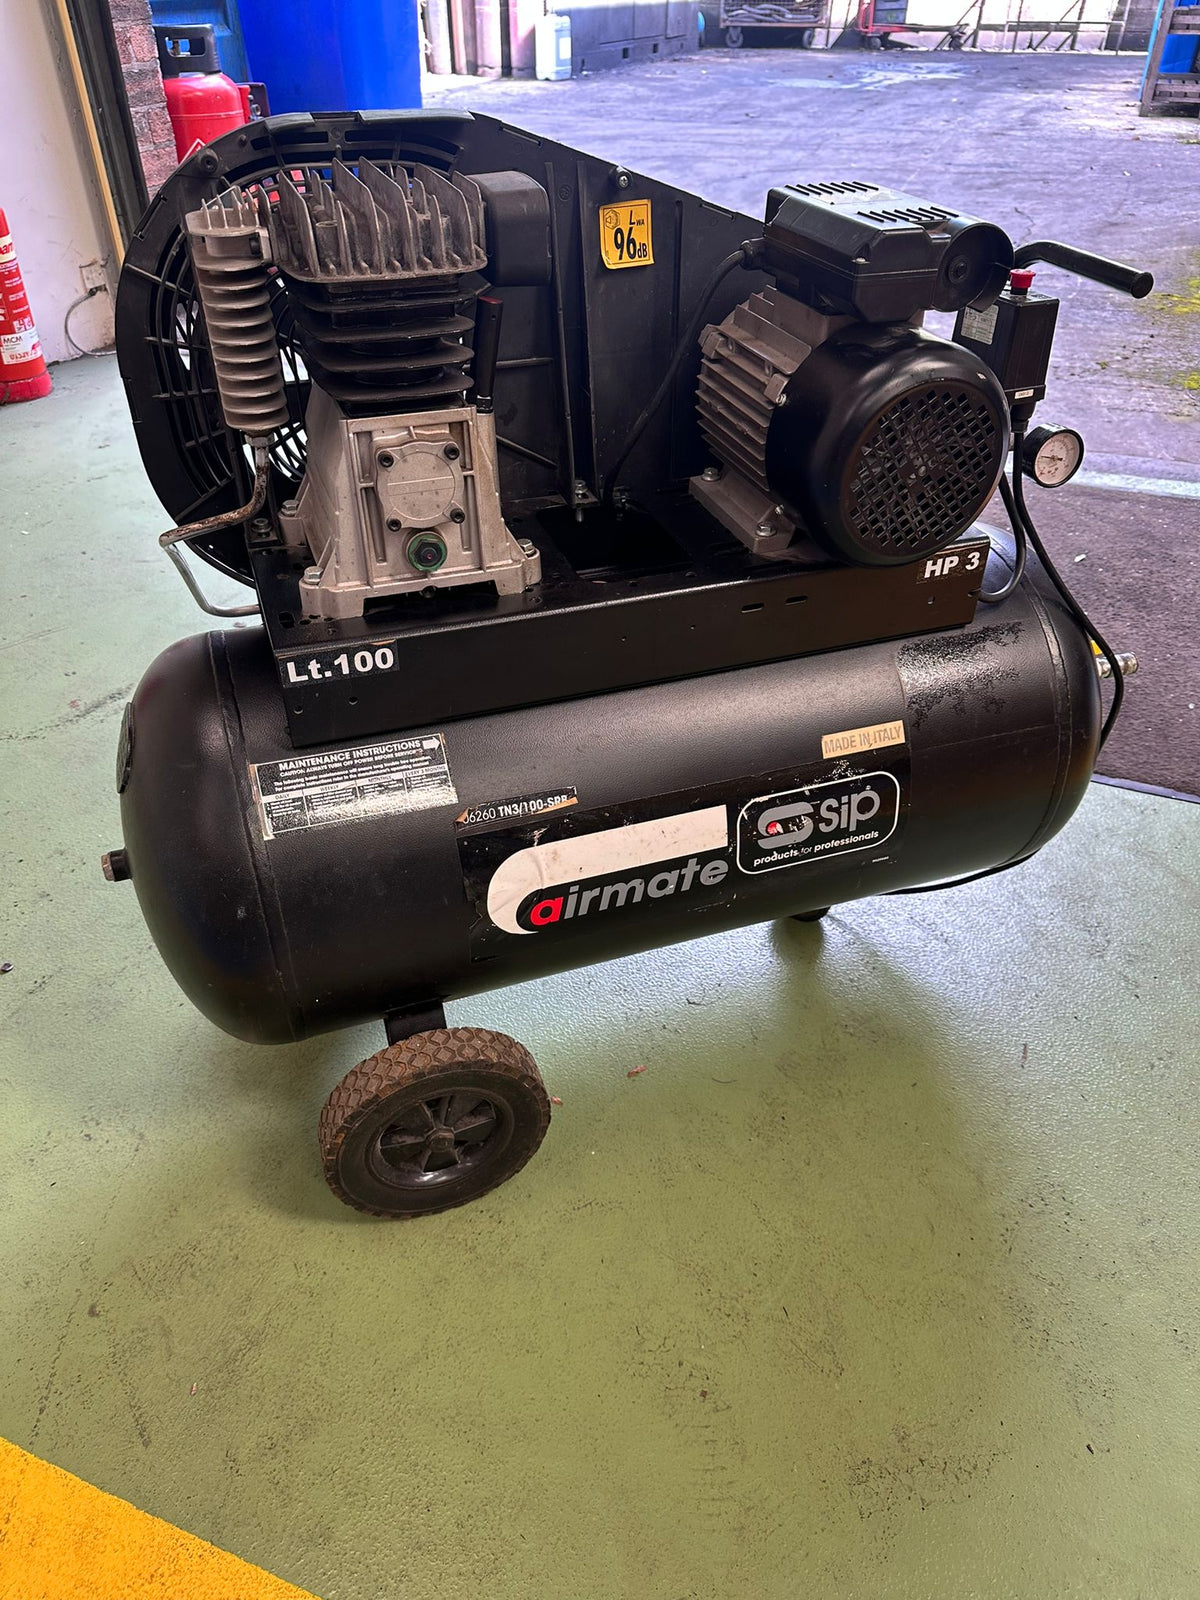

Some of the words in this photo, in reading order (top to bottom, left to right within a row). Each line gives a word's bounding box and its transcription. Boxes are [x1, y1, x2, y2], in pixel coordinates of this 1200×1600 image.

[3, 336, 23, 344] MCM
[924, 555, 960, 578] HP
[965, 551, 980, 570] 3
[286, 648, 394, 683] Lt.100
[824, 735, 857, 754] MADE
[858, 731, 871, 746] IN
[873, 726, 901, 744] ITALY
[279, 752, 351, 771] MAINTENANCE
[353, 740, 421, 758] INSTRUCTIONS
[306, 764, 328, 772] ALWAYS
[368, 775, 392, 783] MONTHLY
[753, 849, 799, 867] products
[800, 846, 813, 855] for
[814, 830, 879, 853] professionals
[530, 857, 729, 926] airmate
